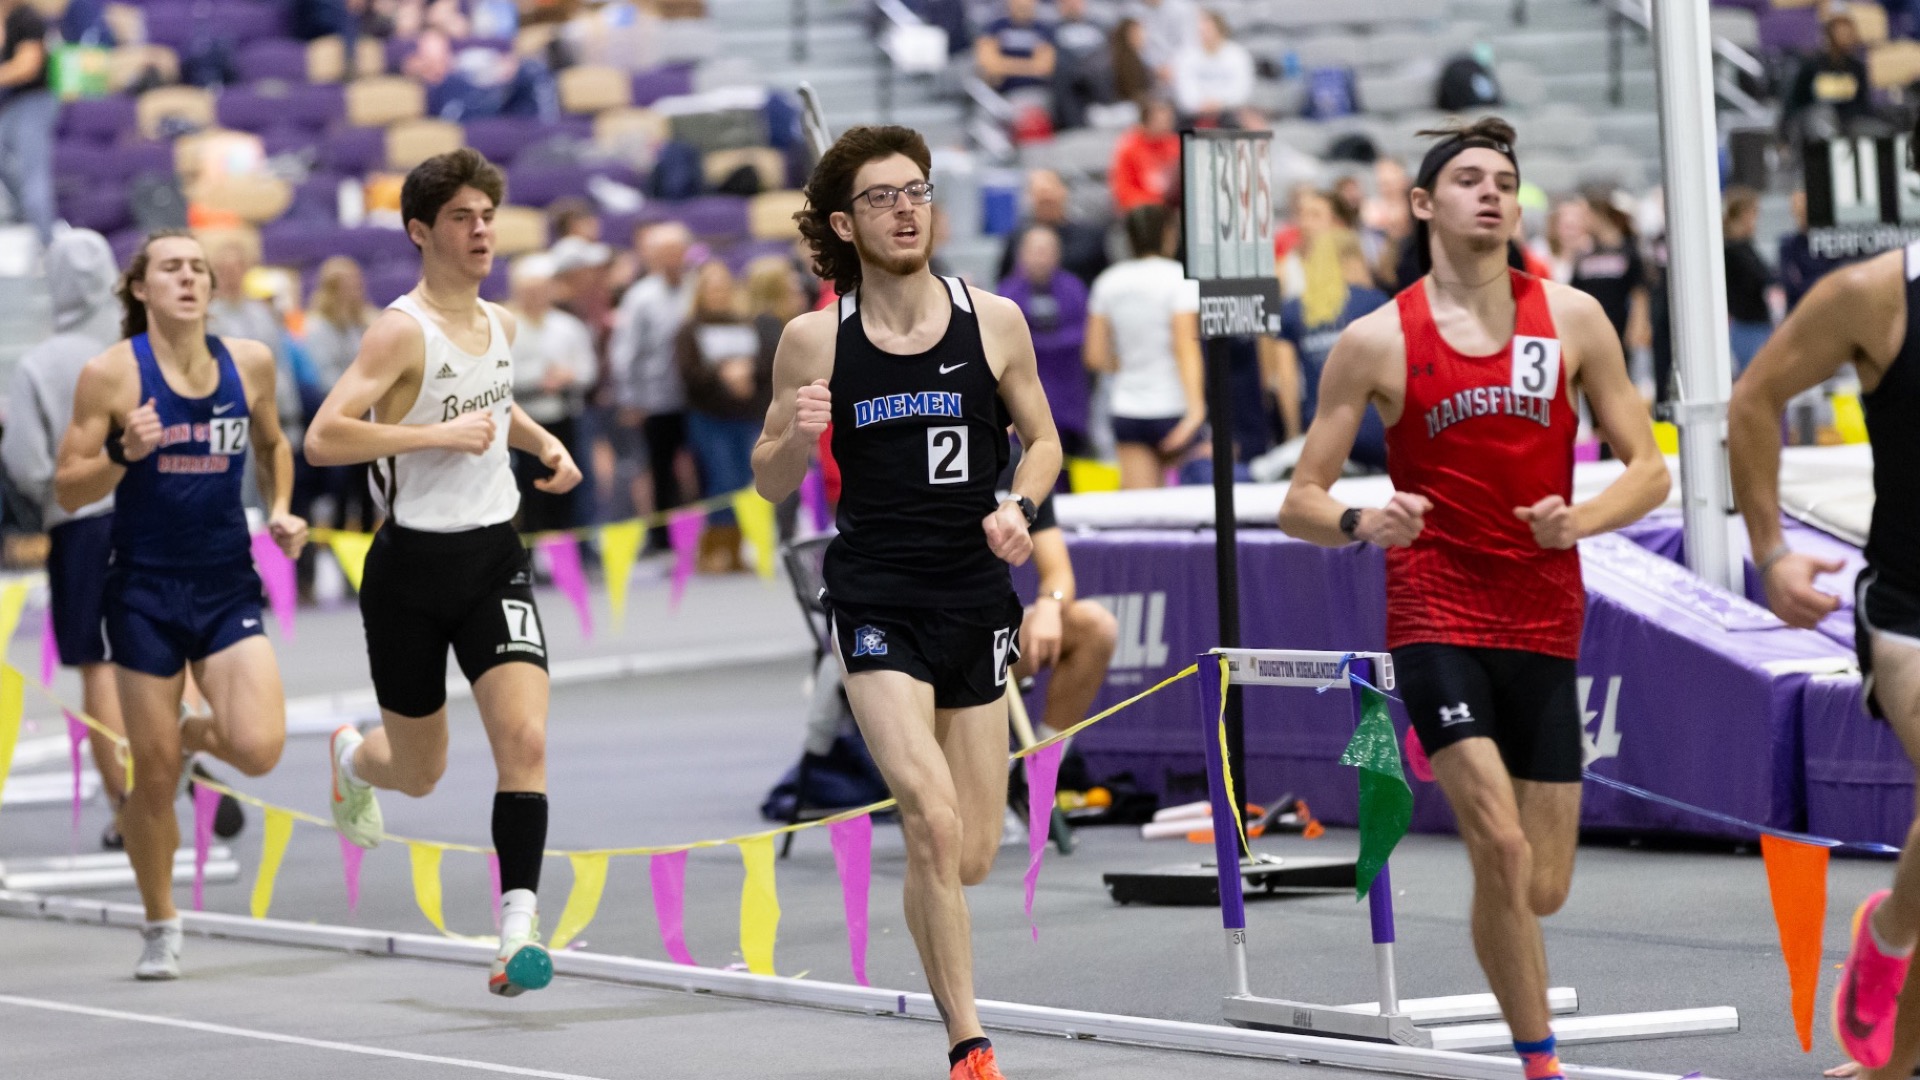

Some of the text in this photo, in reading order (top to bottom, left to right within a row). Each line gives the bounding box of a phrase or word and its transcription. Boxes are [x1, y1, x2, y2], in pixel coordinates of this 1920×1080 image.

[1201, 295, 1265, 335] PERFORMANCE
[1522, 341, 1546, 392] 3
[853, 391, 963, 428] DAEMEN
[1424, 386, 1551, 439] MANSFIELD
[216, 422, 244, 450] 12
[933, 431, 962, 480] 2
[507, 604, 528, 638] 7
[1233, 932, 1246, 945] 30
